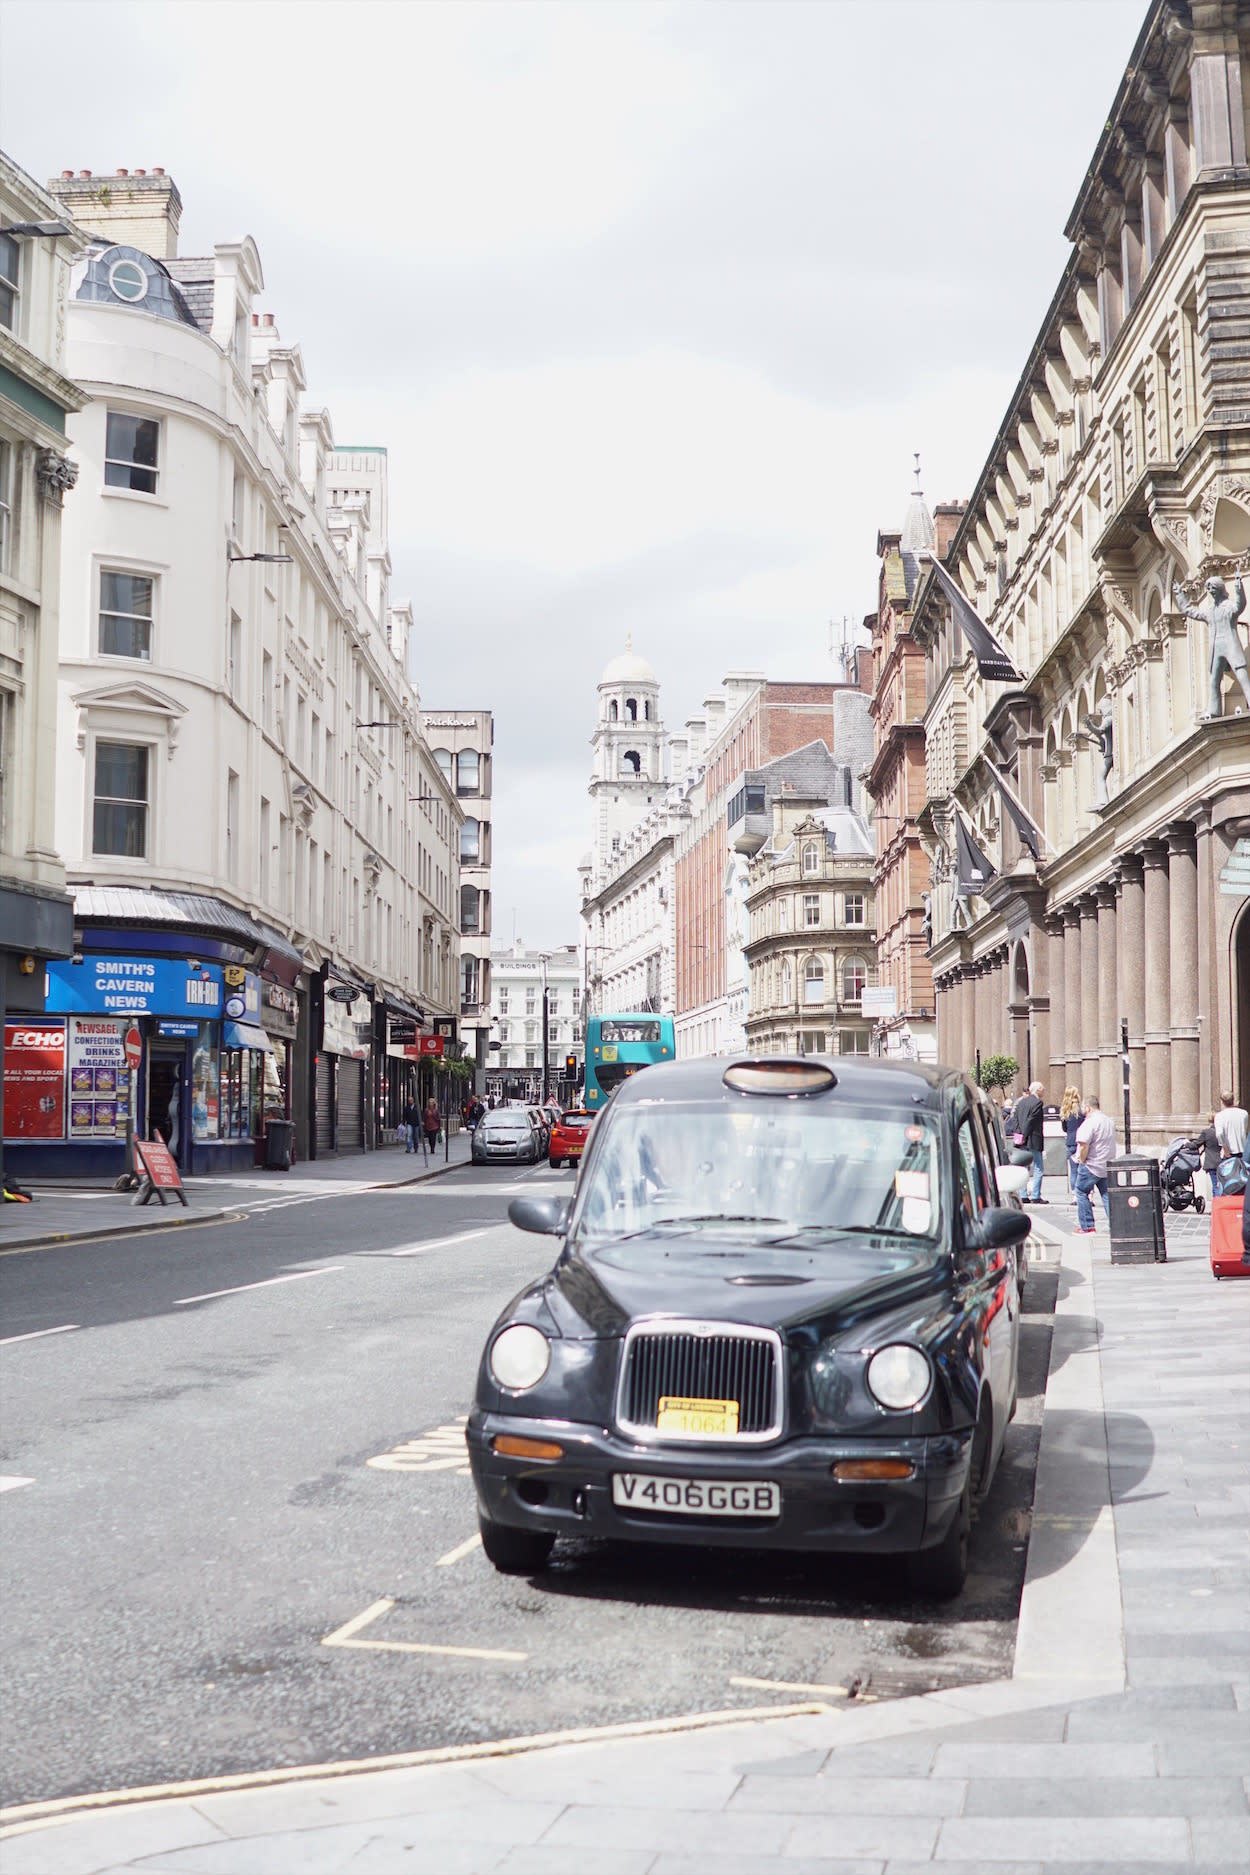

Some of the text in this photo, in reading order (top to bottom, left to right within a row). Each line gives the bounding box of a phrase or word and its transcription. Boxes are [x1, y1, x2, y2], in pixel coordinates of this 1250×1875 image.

[96, 962, 156, 976] SMITH'S
[96, 979, 155, 993] CAVERN
[104, 996, 148, 1009] NEWS
[12, 1032, 65, 1046] ECHO
[85, 1048, 121, 1056] DRINKS
[79, 1058, 127, 1067] MAGAZINES
[682, 1415, 727, 1434] 1064
[620, 1477, 774, 1511] V406GGB
